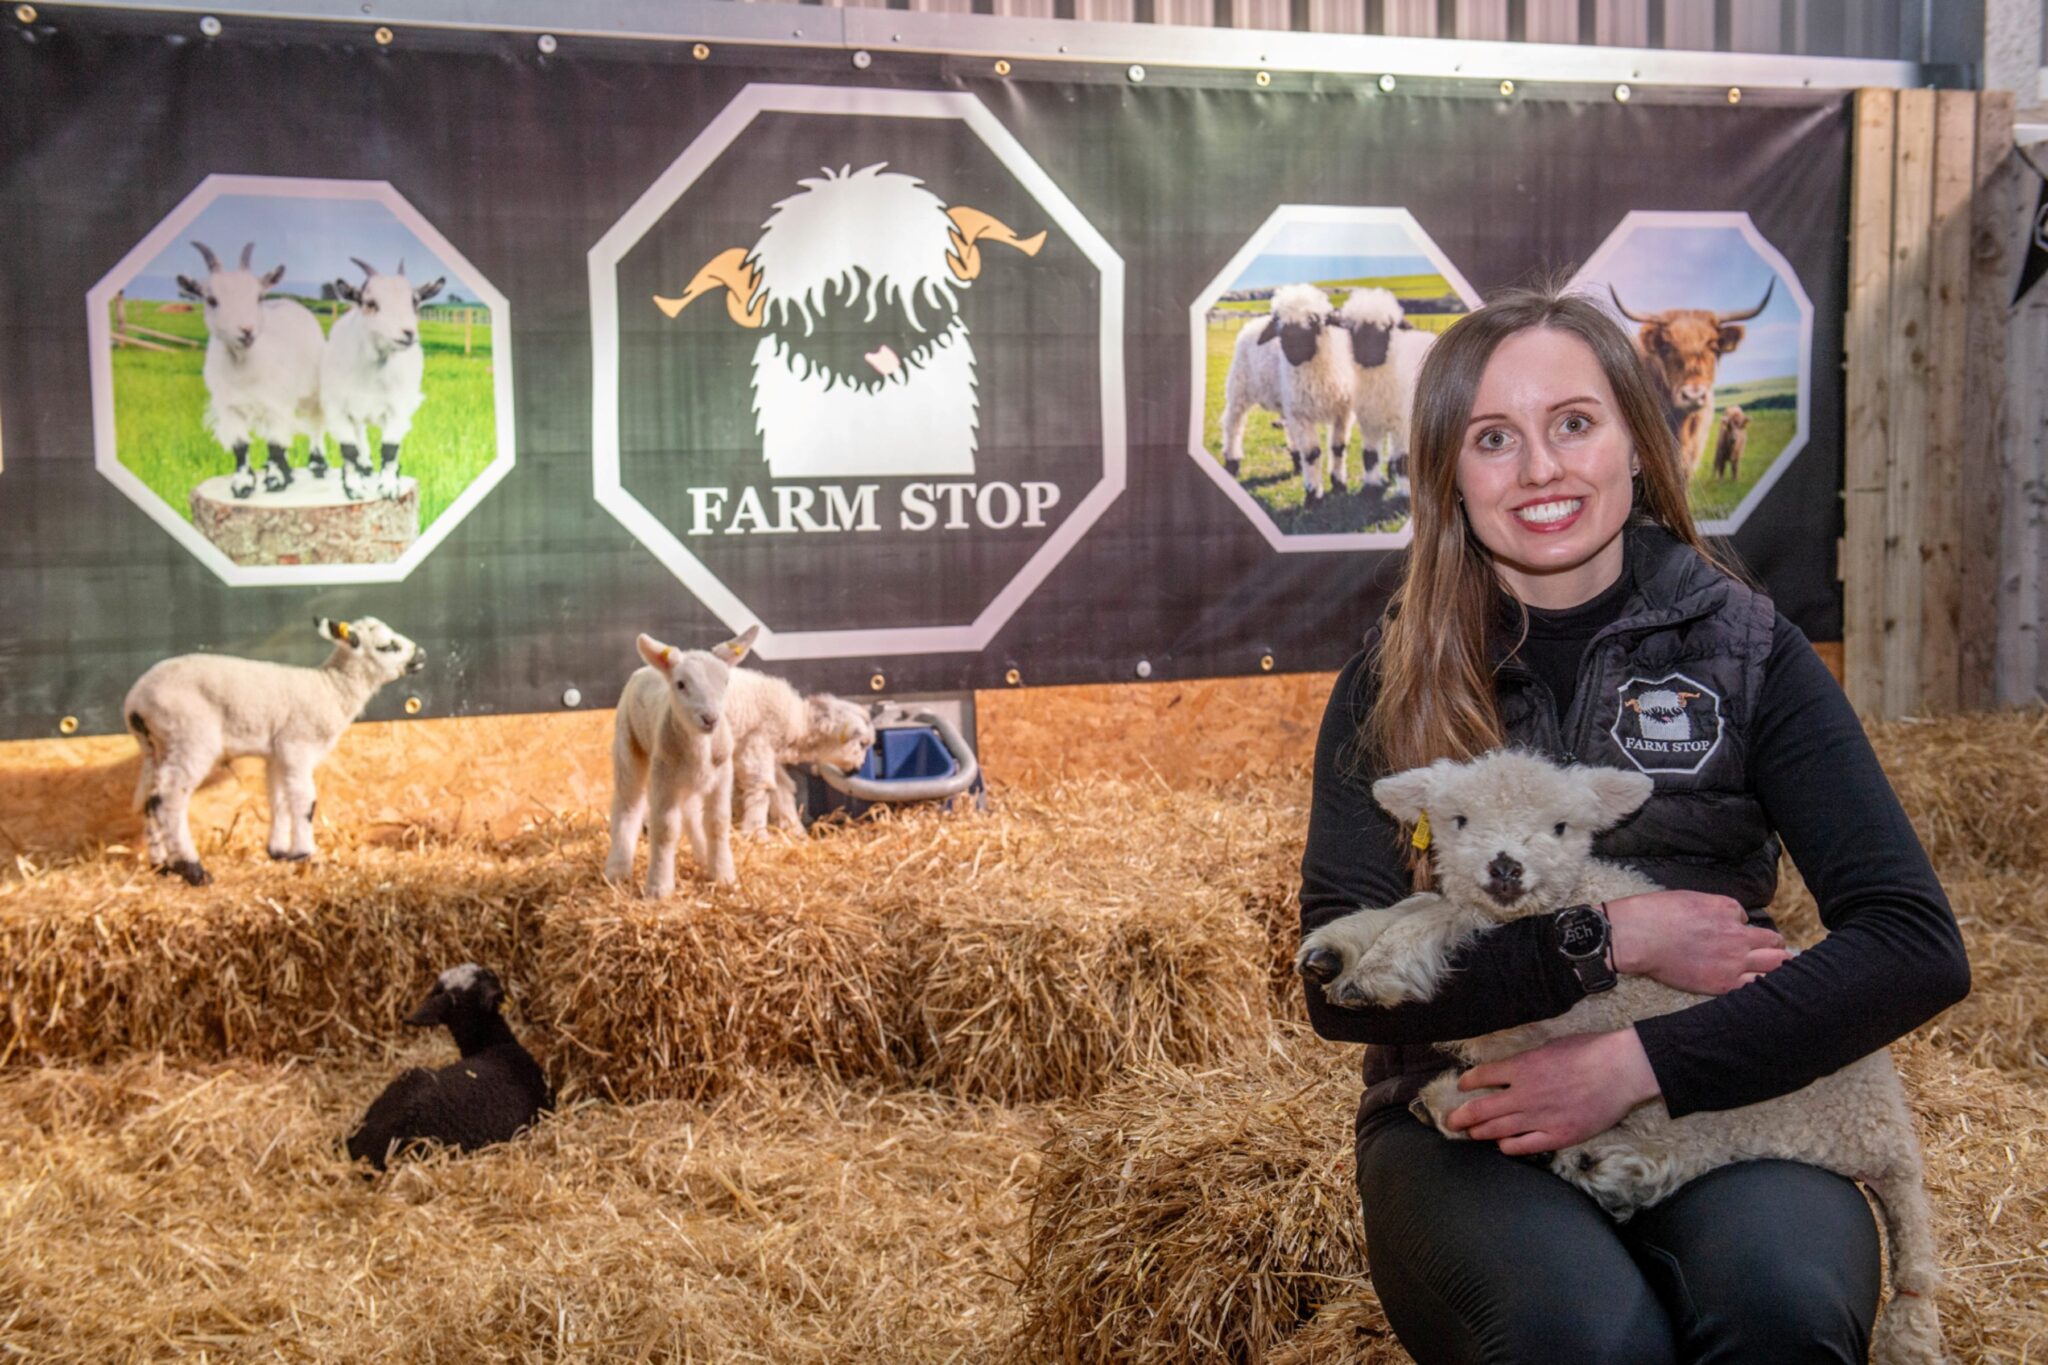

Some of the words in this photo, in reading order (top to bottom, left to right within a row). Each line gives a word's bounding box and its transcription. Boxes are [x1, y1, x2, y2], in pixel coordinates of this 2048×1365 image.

[686, 485, 881, 535] FARM
[900, 482, 1061, 531] STOP
[1625, 737, 1669, 752] FARM
[1672, 740, 1710, 752] STOP
